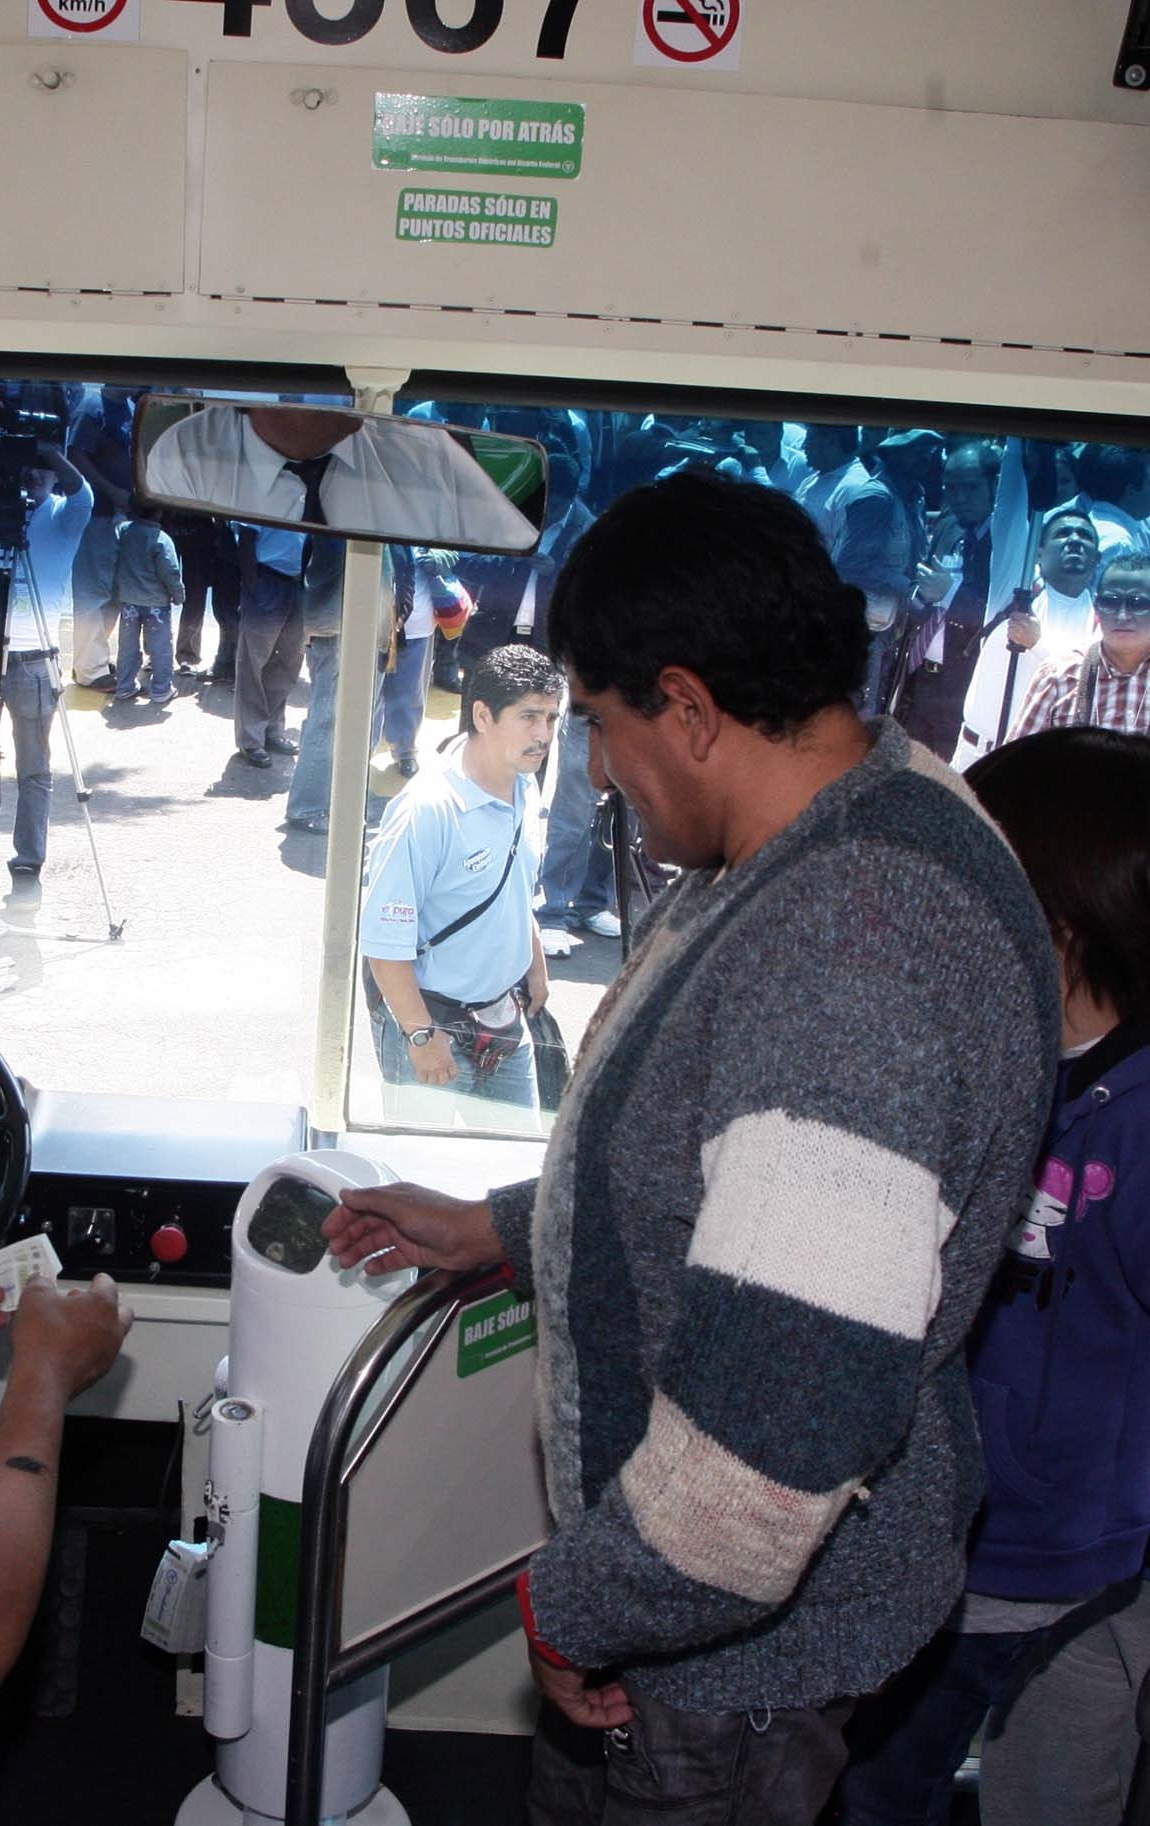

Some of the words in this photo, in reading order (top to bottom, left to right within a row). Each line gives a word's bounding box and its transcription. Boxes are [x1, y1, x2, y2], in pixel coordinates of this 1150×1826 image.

[58, 0, 106, 12] km/h
[428, 113, 475, 138] SÓLO
[478, 118, 515, 142] POR
[517, 120, 576, 145] ATRÁS
[403, 192, 481, 215] PARADAS
[484, 195, 527, 218] SÓLO
[529, 200, 551, 219] EN
[399, 217, 466, 240] PUNTOS
[468, 221, 552, 245] OFICIALES
[464, 1316, 496, 1346] BAJE
[497, 1301, 530, 1332] SÓLO
